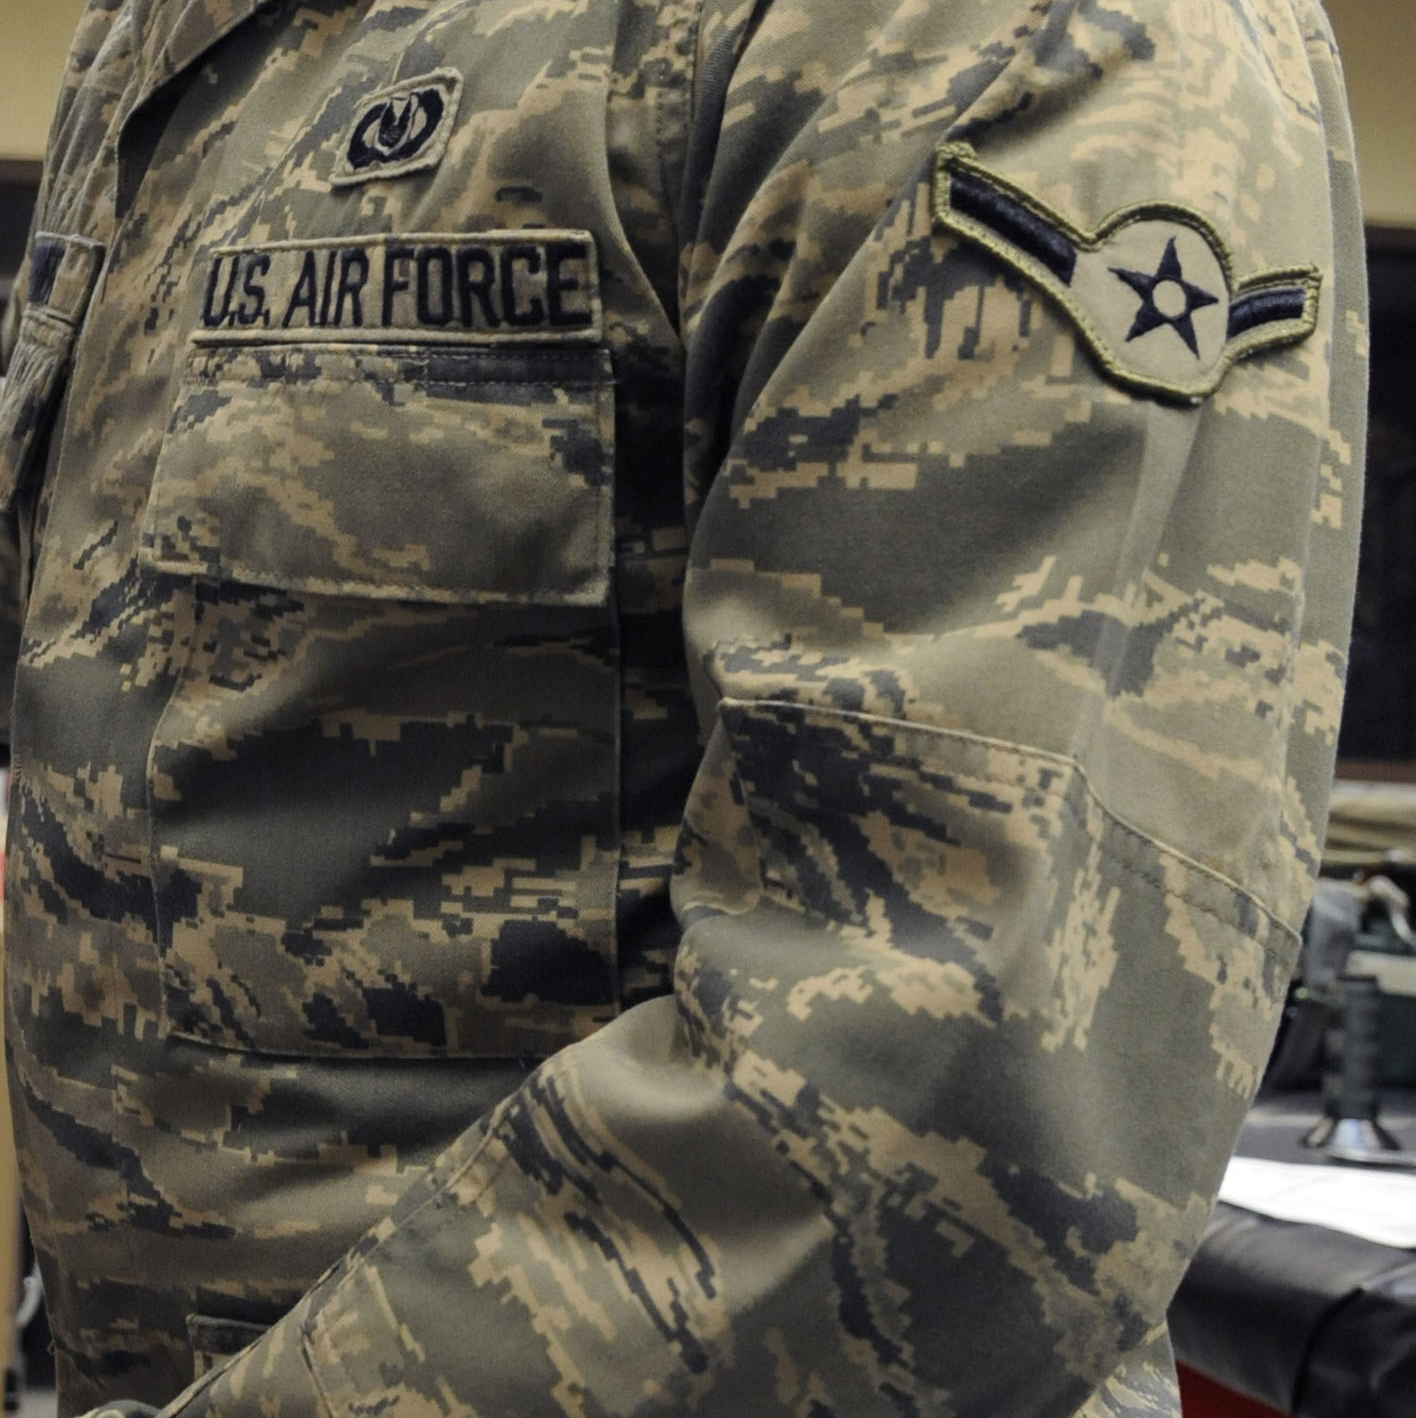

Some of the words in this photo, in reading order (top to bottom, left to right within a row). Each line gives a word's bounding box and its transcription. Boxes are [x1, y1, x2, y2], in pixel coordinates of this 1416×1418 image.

[201, 250, 271, 327] U.S.
[281, 246, 368, 327] AIR
[382, 242, 595, 328] FORCE
